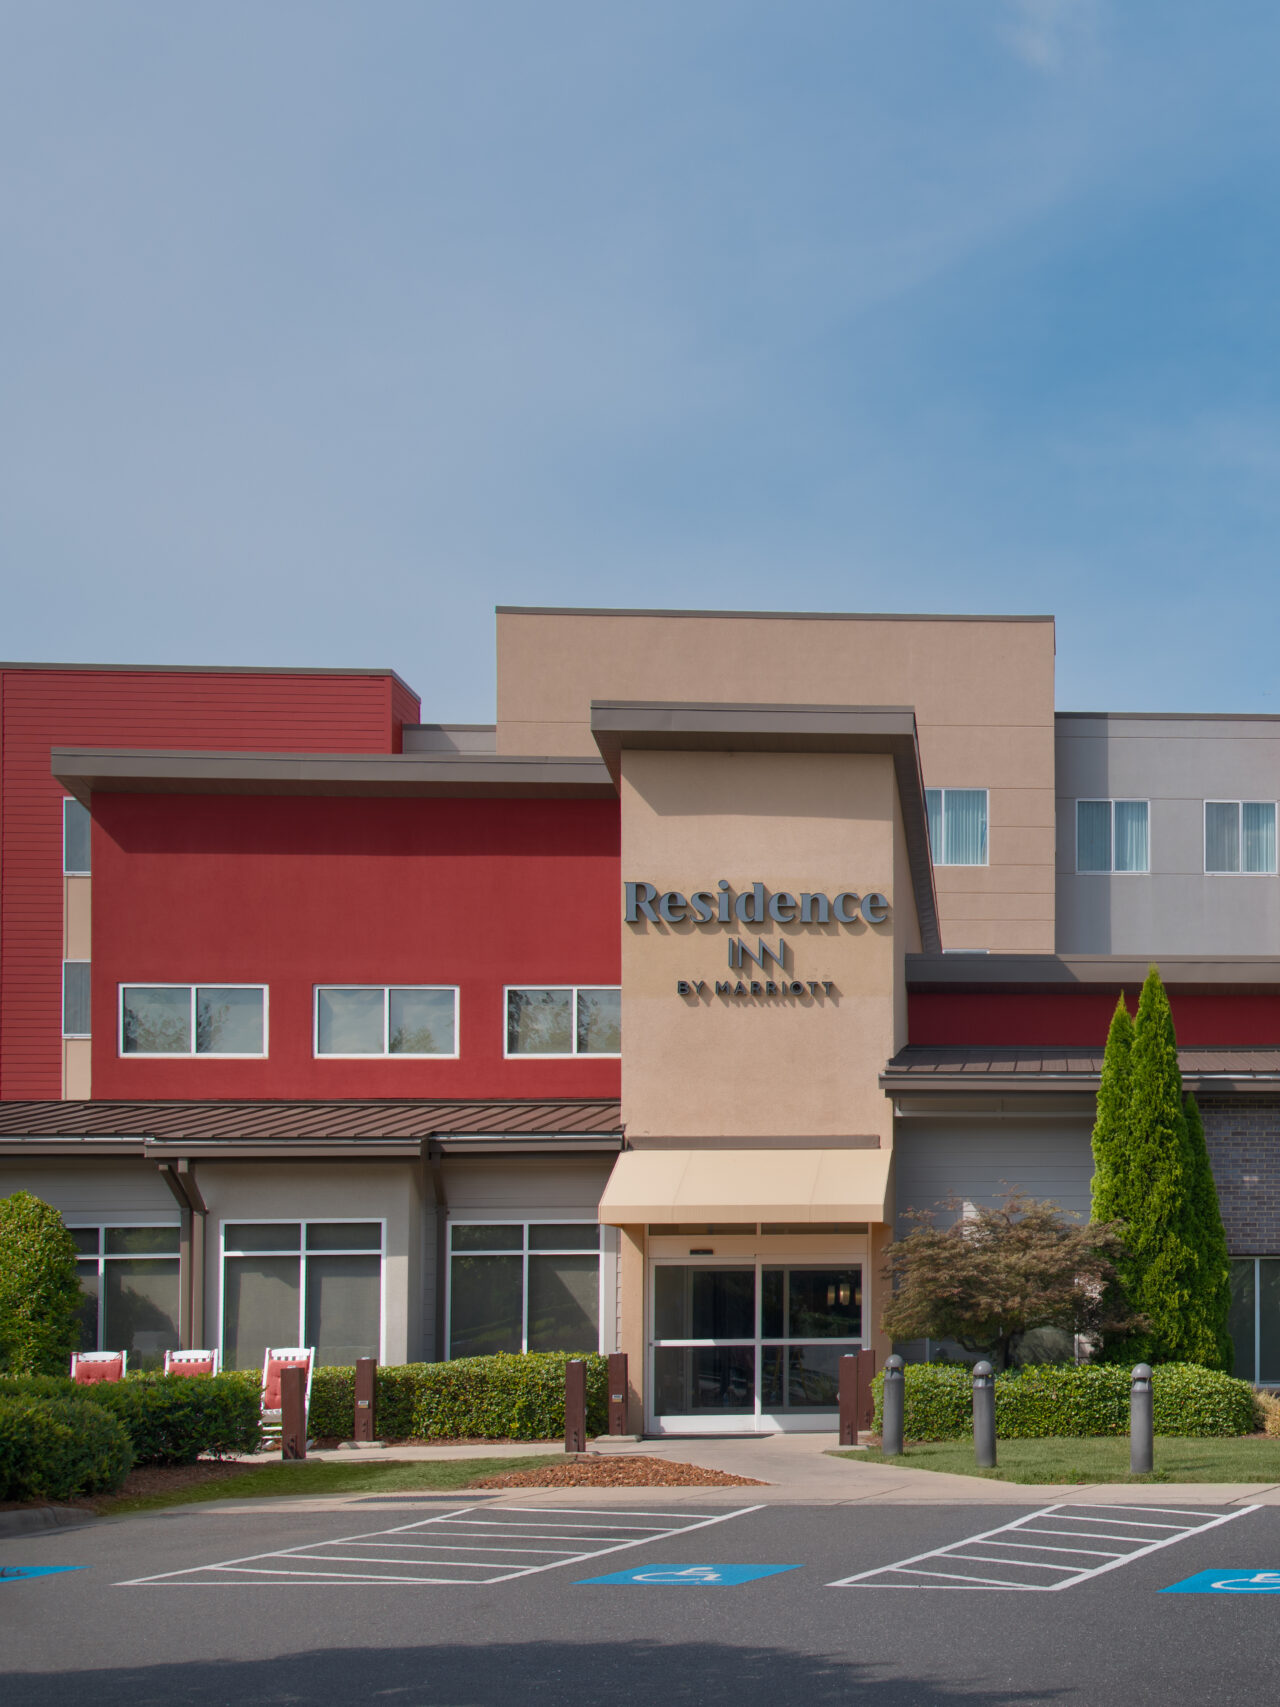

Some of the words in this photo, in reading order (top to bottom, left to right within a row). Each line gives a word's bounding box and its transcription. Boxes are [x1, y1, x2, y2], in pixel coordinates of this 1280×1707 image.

[624, 879, 888, 923] Residence
[728, 937, 784, 969] INN
[677, 981, 704, 995] BY
[715, 981, 833, 996] MARRIOTT
